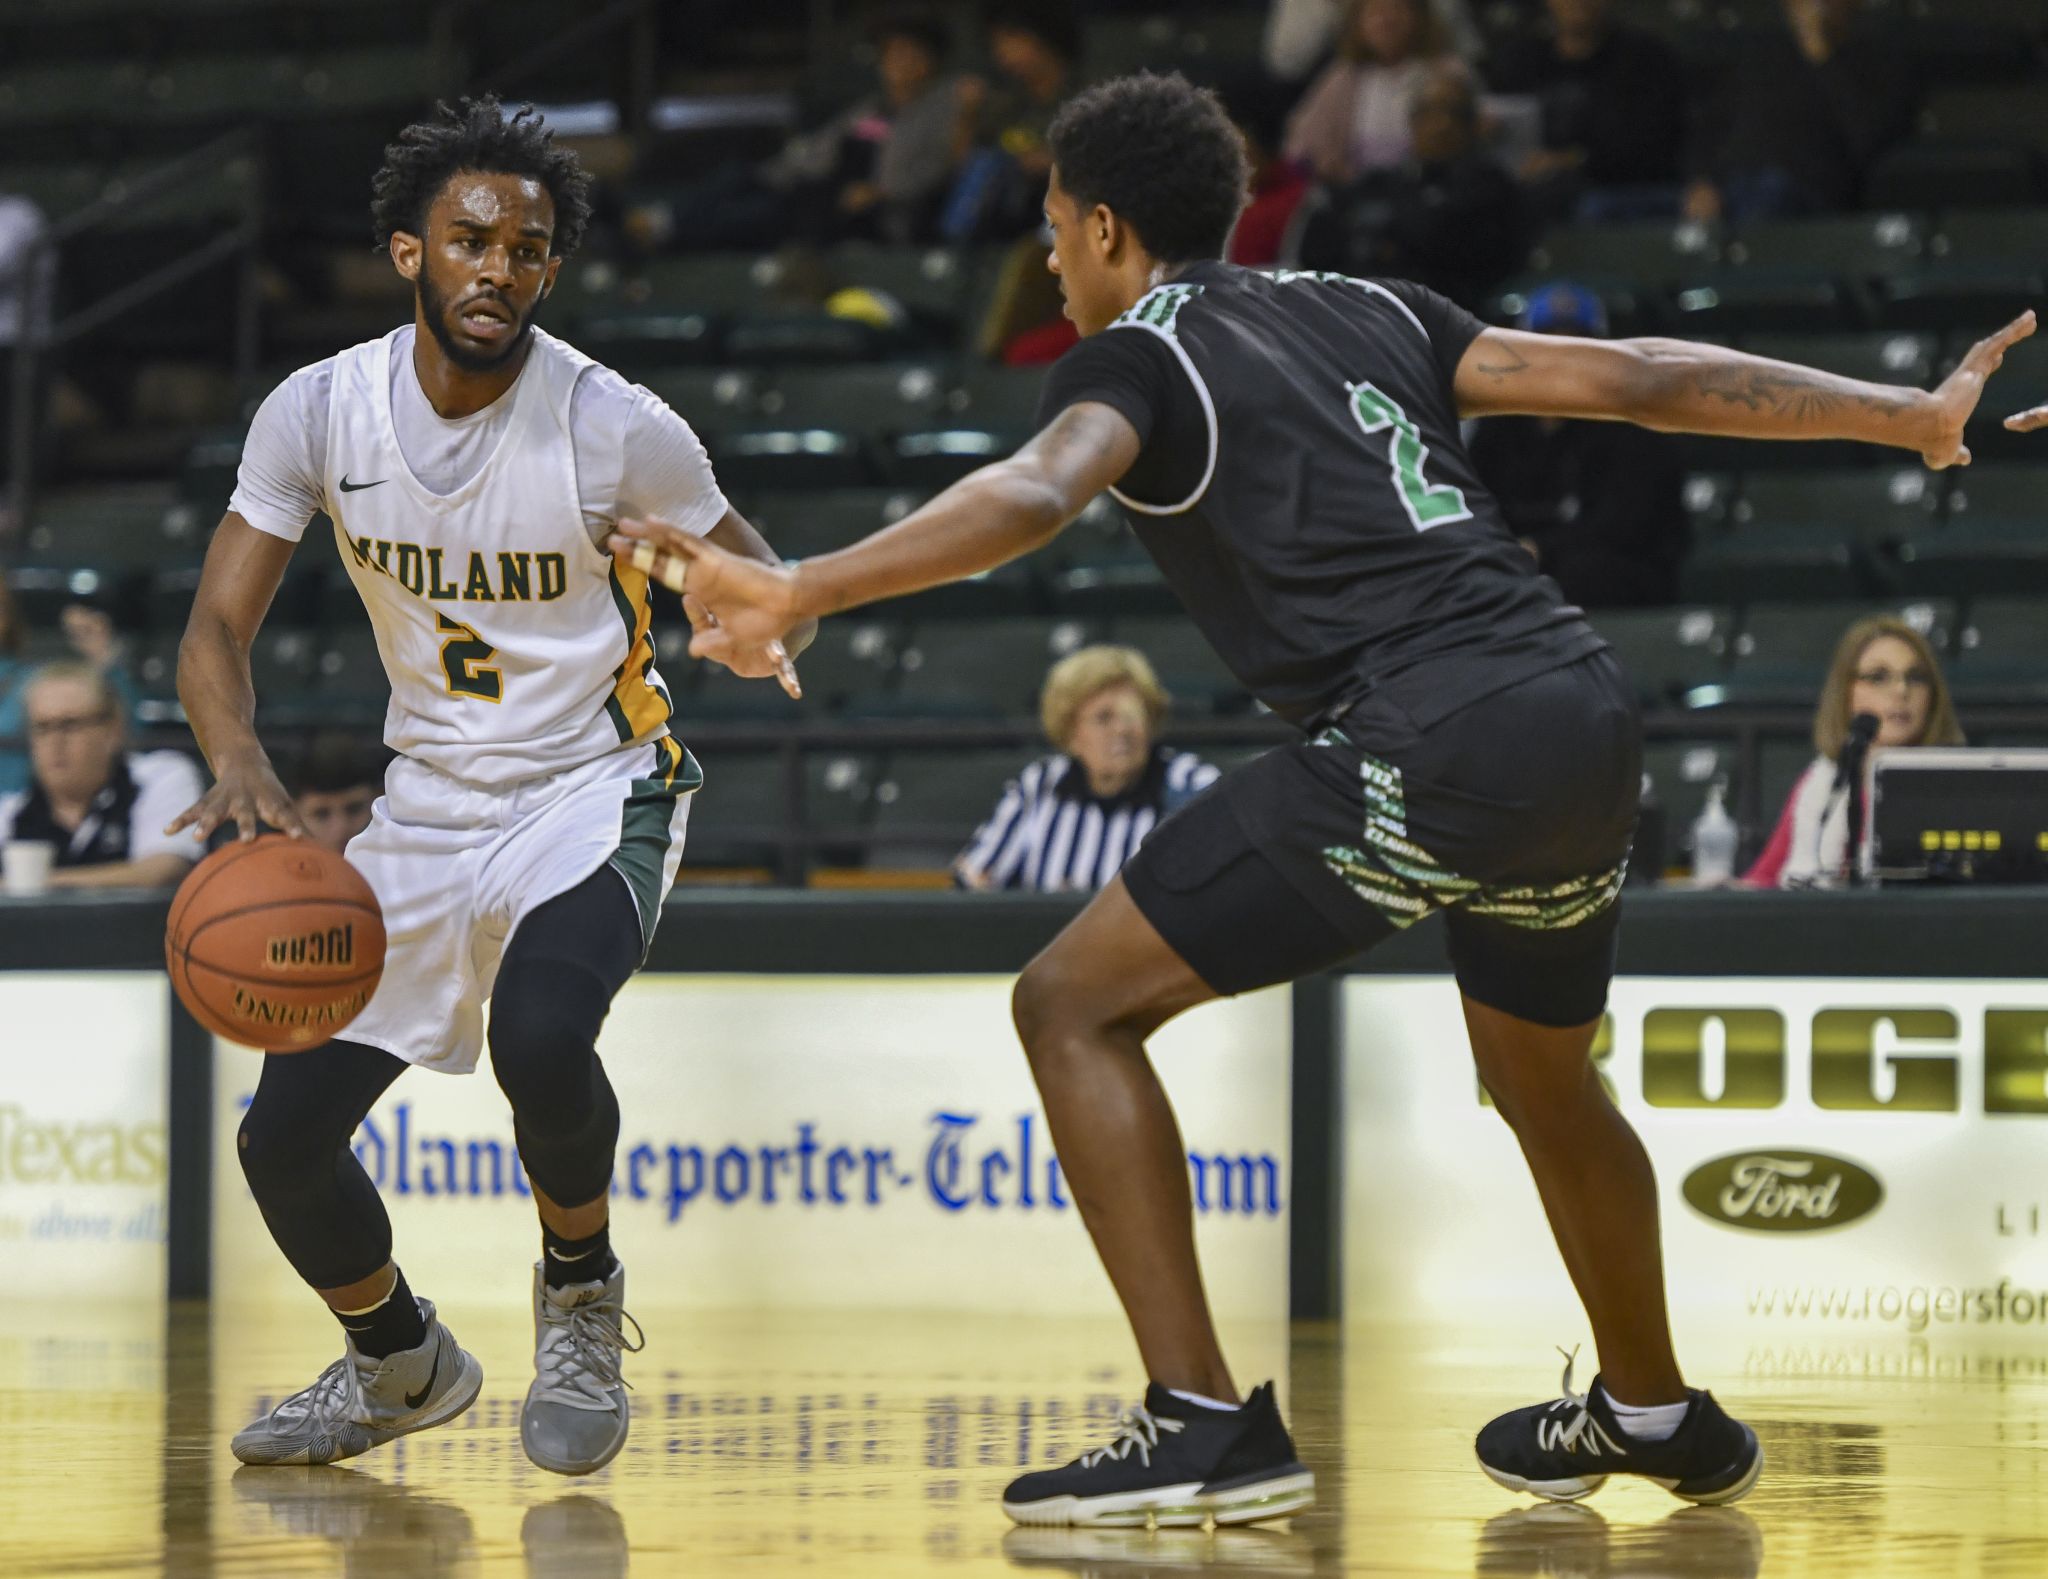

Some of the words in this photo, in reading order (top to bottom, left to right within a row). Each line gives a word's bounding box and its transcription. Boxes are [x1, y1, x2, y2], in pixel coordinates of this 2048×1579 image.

[1345, 380, 1474, 532] 2
[346, 530, 567, 602] MIDLAND
[435, 610, 503, 704] 2
[1720, 1156, 1843, 1220] Ford
